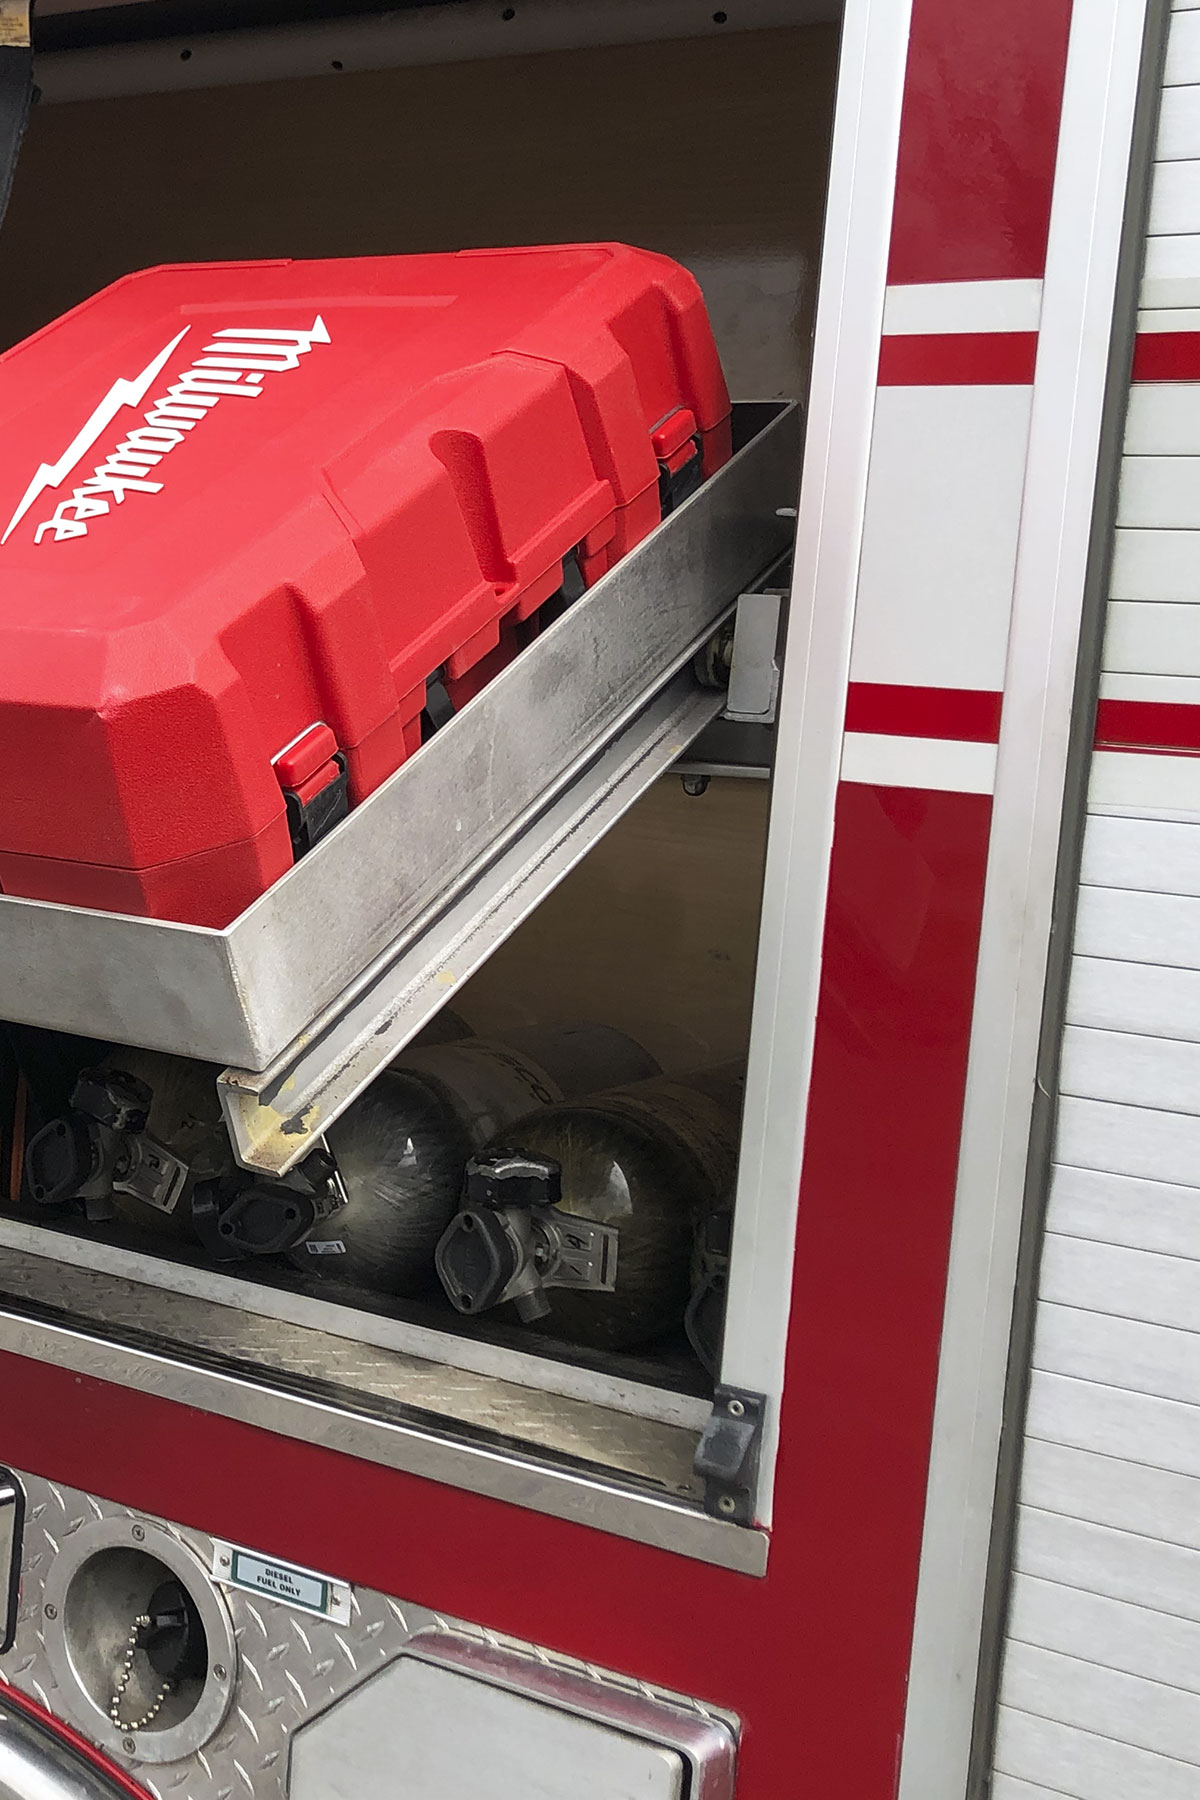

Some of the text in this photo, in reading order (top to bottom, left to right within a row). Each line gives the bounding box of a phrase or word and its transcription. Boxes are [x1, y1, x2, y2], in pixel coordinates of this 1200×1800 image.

[34, 314, 331, 545] Milwaukee
[257, 1575, 301, 1597] FUEL ONLY
[265, 1568, 293, 1584] DIESEL
